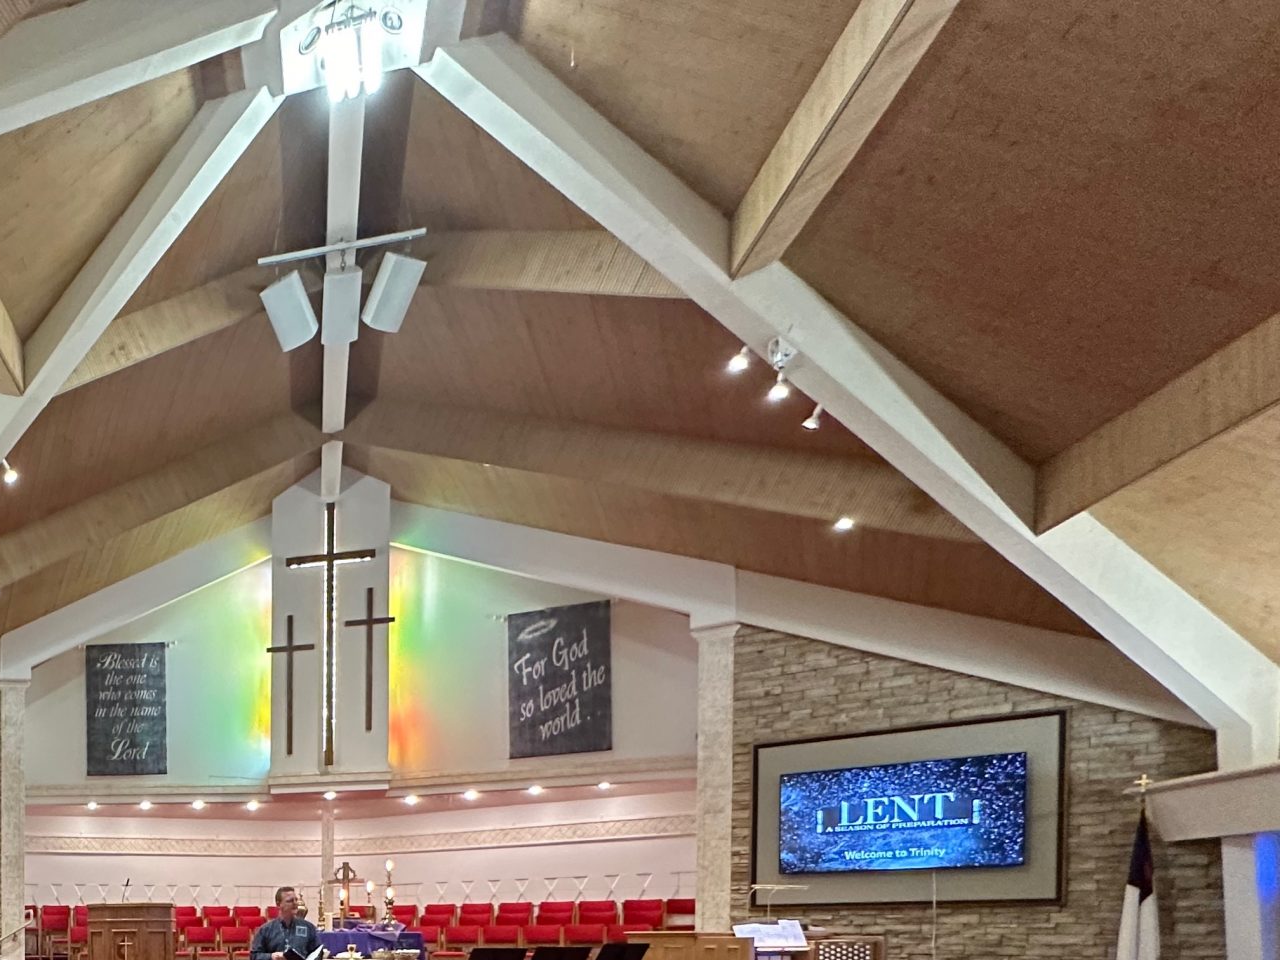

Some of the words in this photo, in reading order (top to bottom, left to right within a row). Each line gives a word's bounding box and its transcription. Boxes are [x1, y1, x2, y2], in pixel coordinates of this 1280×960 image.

[96, 651, 148, 669] Blessed
[150, 655, 159, 668] is
[514, 652, 547, 685] For
[552, 627, 589, 670] God
[105, 671, 123, 685] the
[126, 674, 147, 685] one
[99, 686, 122, 700] who
[124, 689, 158, 700] comes
[520, 699, 534, 721] so
[539, 671, 578, 711] loved
[582, 661, 606, 691] the
[95, 706, 107, 717] in
[109, 703, 128, 717] the
[130, 705, 162, 717] name
[539, 698, 582, 741] world
[111, 719, 128, 739] of
[126, 719, 145, 733] the
[108, 738, 149, 760] Lord
[838, 792, 955, 826] LENT
[876, 822, 890, 830] OF
[893, 818, 968, 828] PREPARATION
[845, 849, 893, 861] Welcome
[895, 849, 907, 859] to
[909, 847, 946, 859] Trinity
